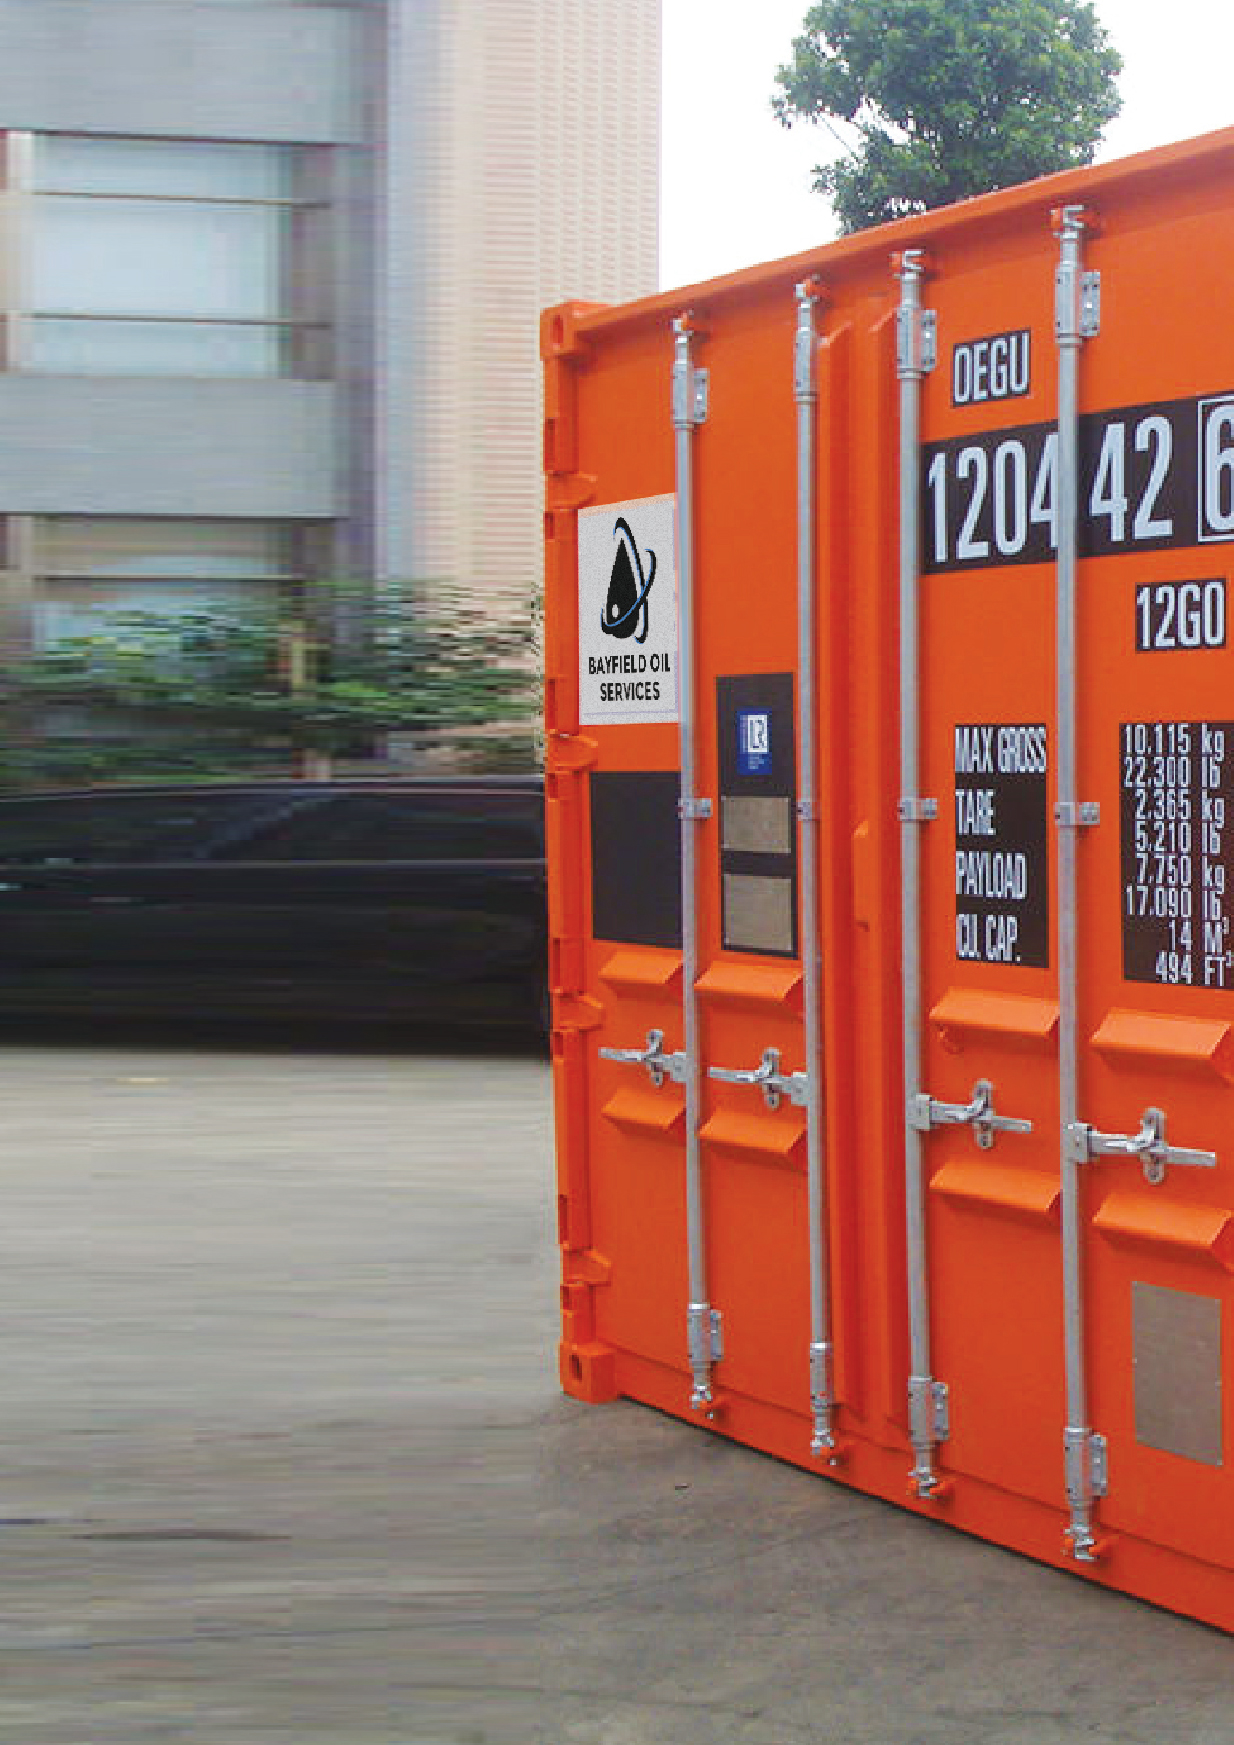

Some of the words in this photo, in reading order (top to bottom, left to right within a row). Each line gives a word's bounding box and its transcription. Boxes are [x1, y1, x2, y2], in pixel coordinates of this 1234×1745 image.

[953, 331, 1030, 403] OEGU
[588, 655, 647, 675] BAYFIELD
[649, 653, 671, 673] OIL
[600, 681, 660, 702] SERVICES
[955, 726, 994, 773] MAX
[998, 726, 1046, 773] GROSS
[1202, 723, 1225, 761] kg
[1202, 756, 1221, 787] lb
[955, 789, 996, 835] TARE
[1202, 788, 1225, 828] kg
[1202, 820, 1221, 853] lb
[955, 851, 1027, 899] PAYLOAD
[1202, 855, 1225, 894] kg
[1202, 888, 1221, 921] lb
[985, 914, 1021, 962] CAP.
[1168, 920, 1192, 950] 14
[1155, 951, 1192, 984] 494
